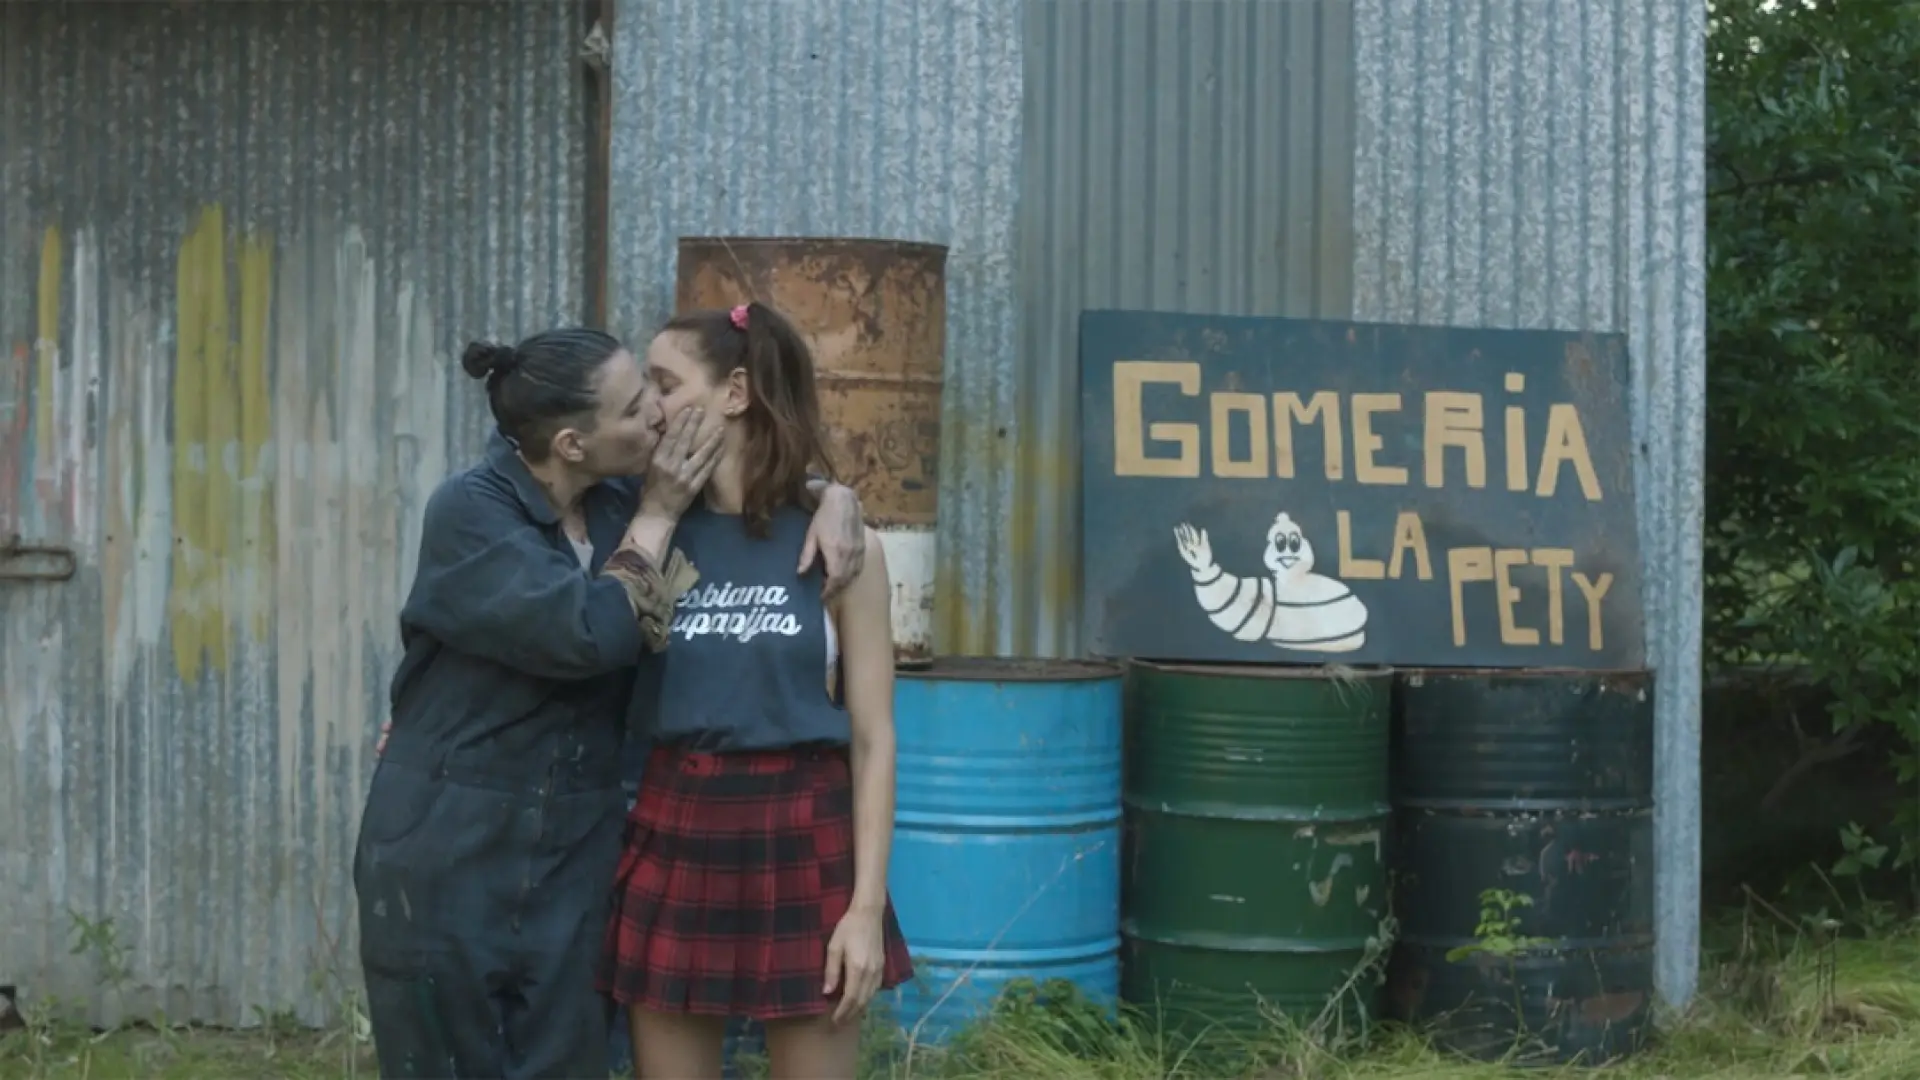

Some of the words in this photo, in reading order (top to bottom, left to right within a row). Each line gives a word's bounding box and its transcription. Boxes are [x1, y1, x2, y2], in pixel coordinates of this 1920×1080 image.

[1336, 510, 1433, 581] LA
[675, 581, 789, 608] esbiana
[1447, 546, 1614, 651] PETY
[671, 607, 802, 643] upapijas
